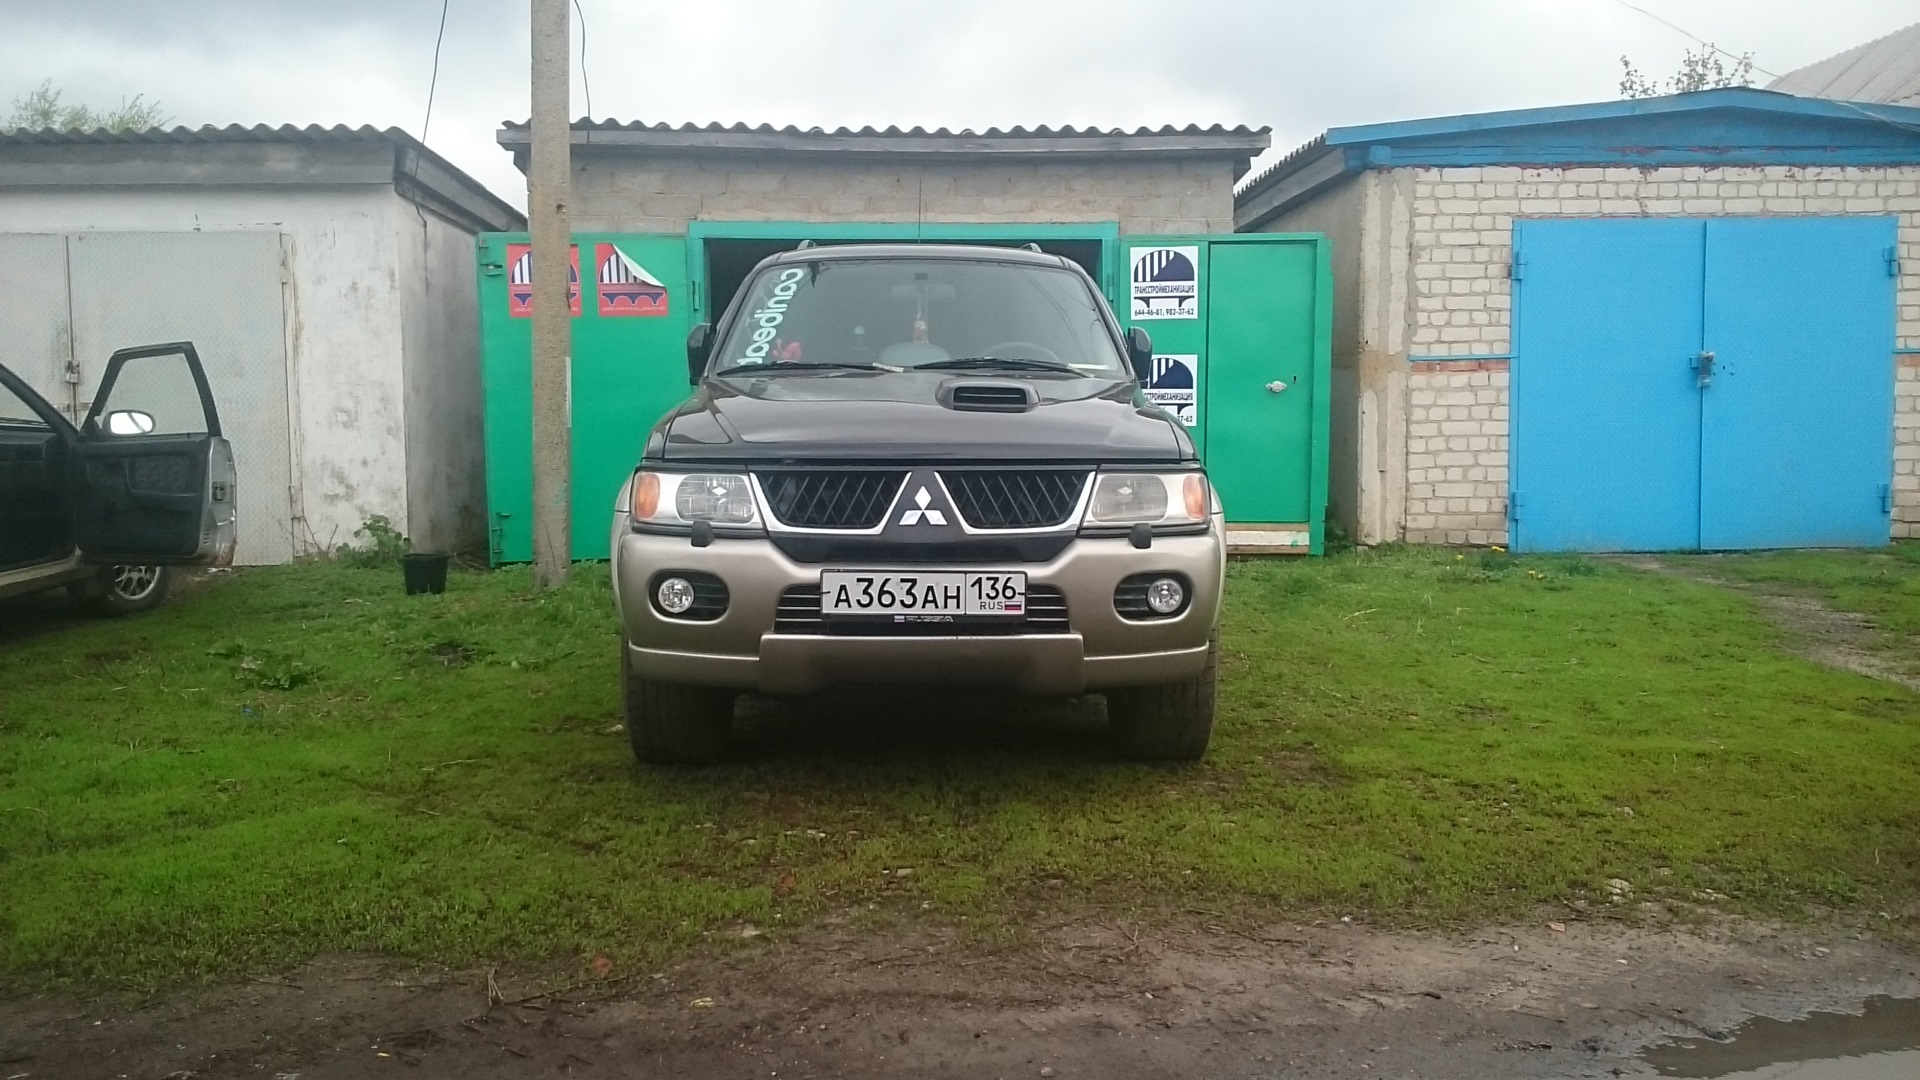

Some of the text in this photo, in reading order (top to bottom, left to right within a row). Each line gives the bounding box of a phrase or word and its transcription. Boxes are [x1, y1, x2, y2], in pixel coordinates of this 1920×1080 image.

[1134, 284, 1195, 295] ТРАНССТРОЙМЕХАНИЗАЦИЯ
[970, 576, 1017, 600] 136
[979, 601, 1004, 611] RUS
